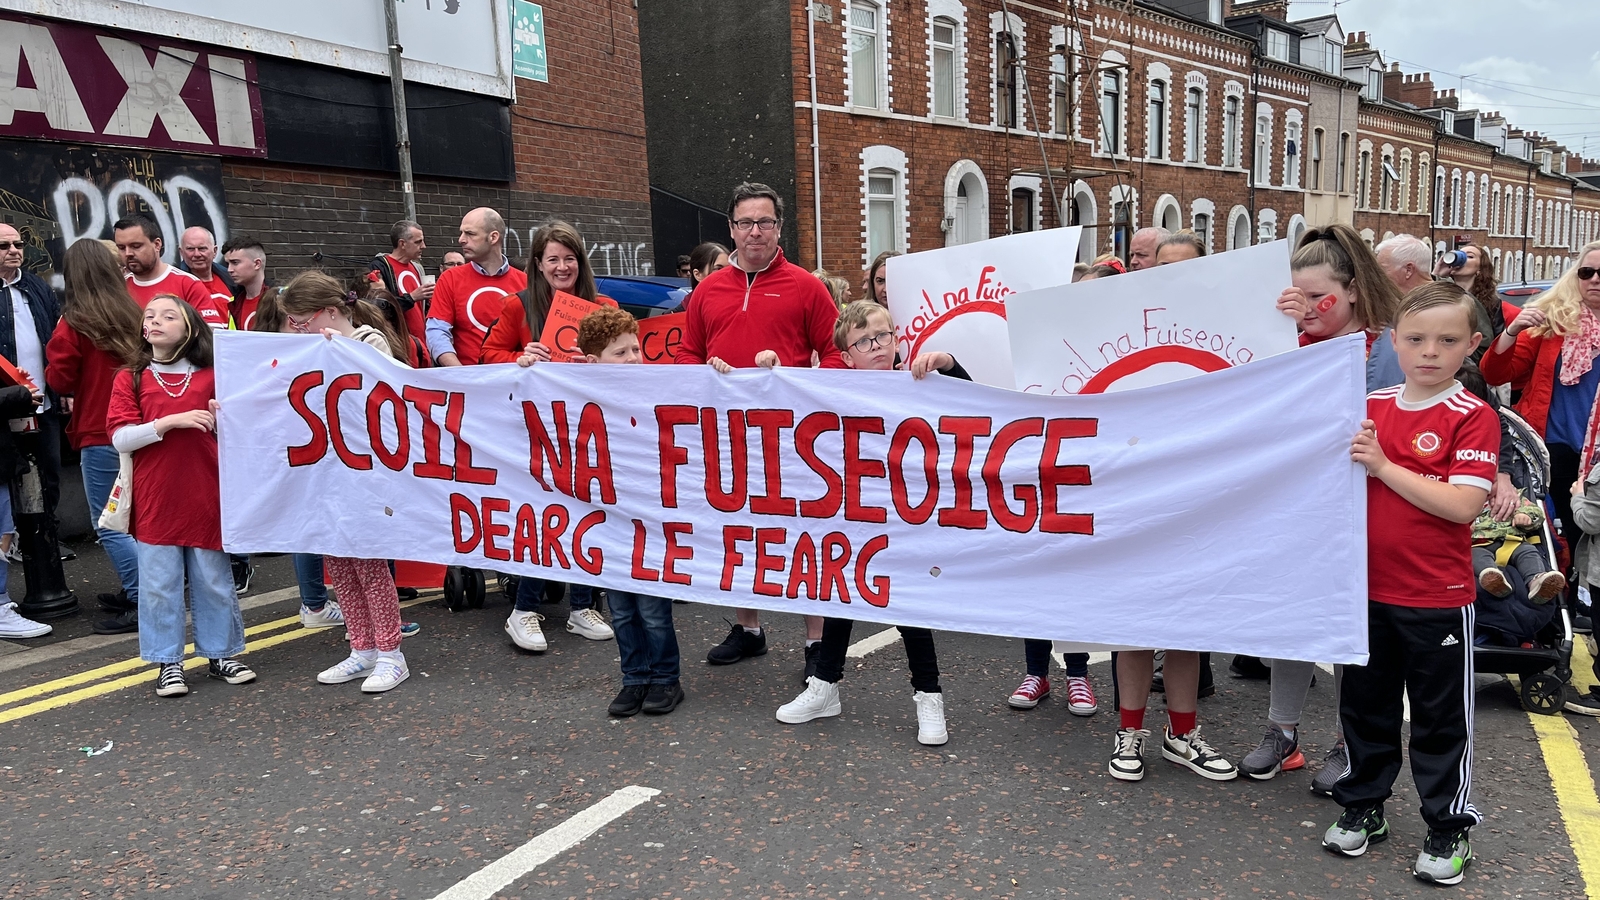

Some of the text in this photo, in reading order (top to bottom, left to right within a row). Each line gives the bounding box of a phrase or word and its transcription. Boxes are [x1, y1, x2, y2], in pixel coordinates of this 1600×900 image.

[569, 300, 591, 313] Scoil
[943, 287, 970, 310] na
[976, 266, 1017, 303] Fuis
[1098, 333, 1139, 364] na
[287, 370, 1098, 536] SCOIL NA FUISEOIGE
[450, 493, 890, 608] DEARG LE FEARG
